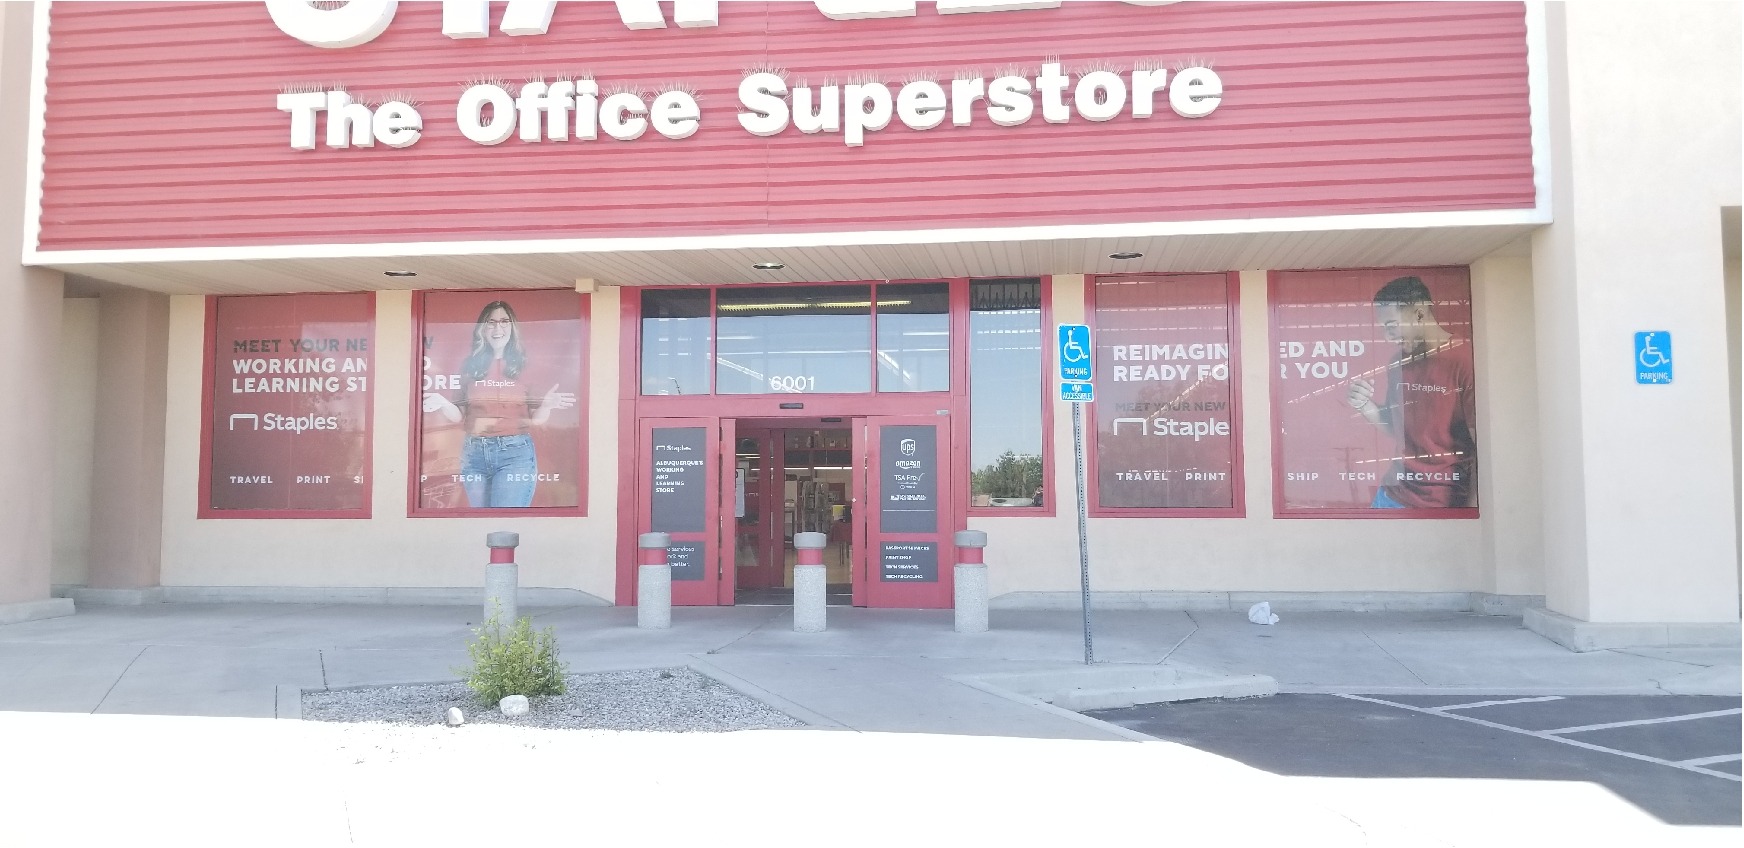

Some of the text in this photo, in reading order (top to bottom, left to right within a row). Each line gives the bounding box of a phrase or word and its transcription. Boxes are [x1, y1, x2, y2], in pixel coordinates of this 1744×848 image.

[276, 62, 1223, 150] The Office Superstore
[233, 339, 281, 353] MEET
[290, 338, 340, 352] YOUR
[1311, 340, 1365, 357] AND
[233, 357, 336, 374] WORKING
[1064, 367, 1088, 376] PARKING
[1295, 361, 1348, 379] YOU
[1113, 365, 1190, 382] READY
[1640, 371, 1669, 380] PARKING
[232, 376, 340, 393] LEARNING
[487, 379, 516, 388] Staples
[770, 375, 815, 391] 6001
[1411, 383, 1447, 394] Staples
[1194, 401, 1226, 411] NEW
[263, 412, 338, 434] Staples
[1153, 417, 1230, 442] Staple
[902, 443, 914, 454] ups
[230, 475, 274, 484] TRAVEL
[296, 475, 331, 484] PRINT
[452, 474, 482, 483] TECH
[507, 473, 560, 483] RECYCLE
[1116, 472, 1226, 481] TRAVEL PRINT
[1287, 472, 1460, 481] SHIP TECH RECYCLE
